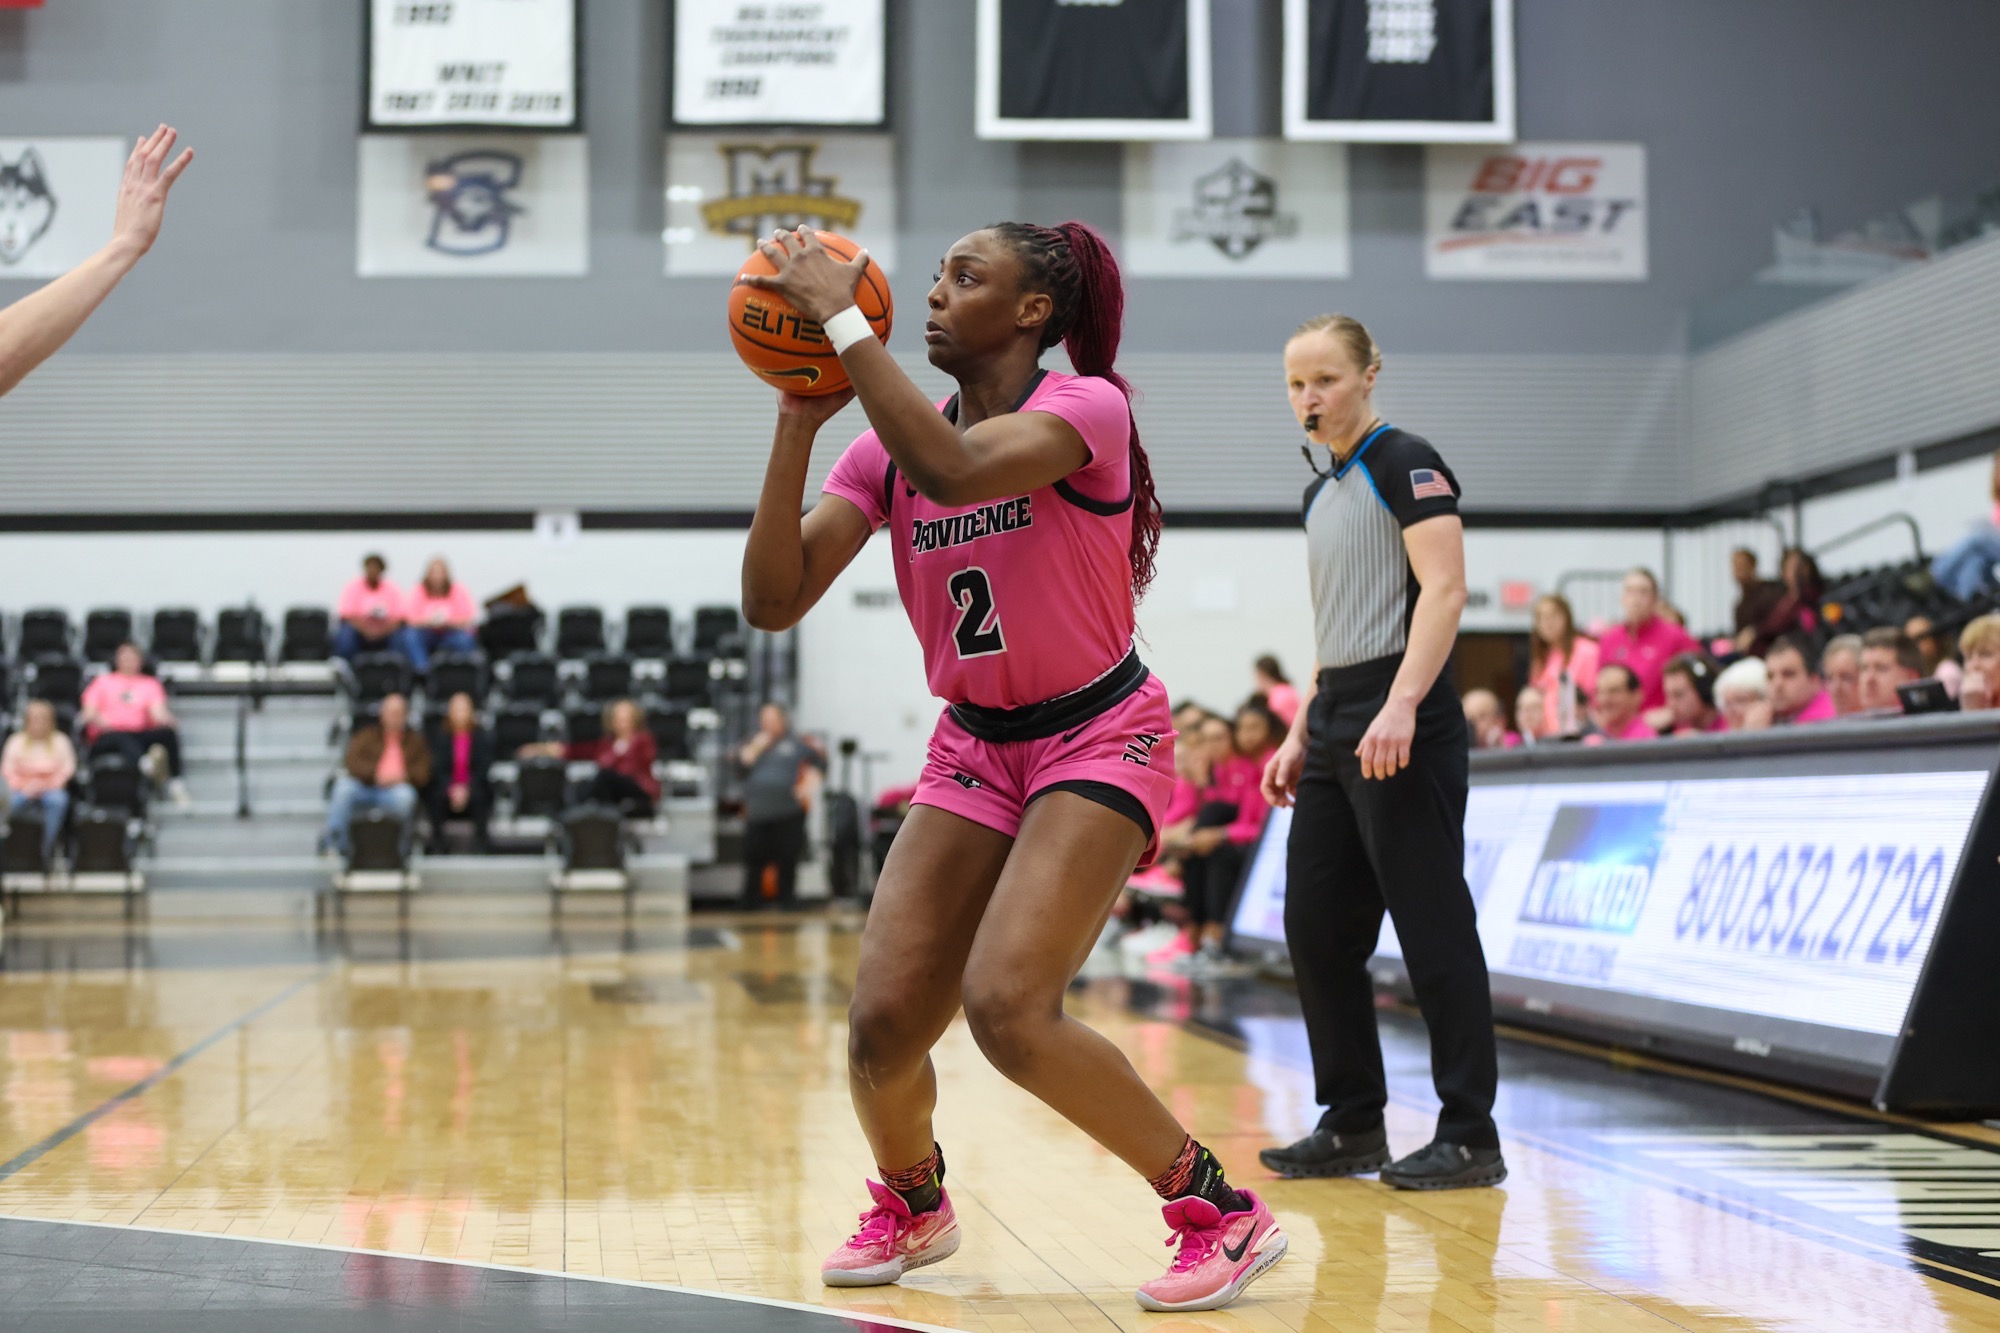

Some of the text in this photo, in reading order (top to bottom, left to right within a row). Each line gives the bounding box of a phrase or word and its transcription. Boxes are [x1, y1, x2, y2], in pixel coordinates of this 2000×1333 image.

[1473, 156, 1604, 196] BIG
[1452, 197, 1636, 236] EAST
[742, 303, 826, 345] ELITE
[910, 495, 1033, 563] PROVIDENCE
[947, 566, 1008, 660] 2
